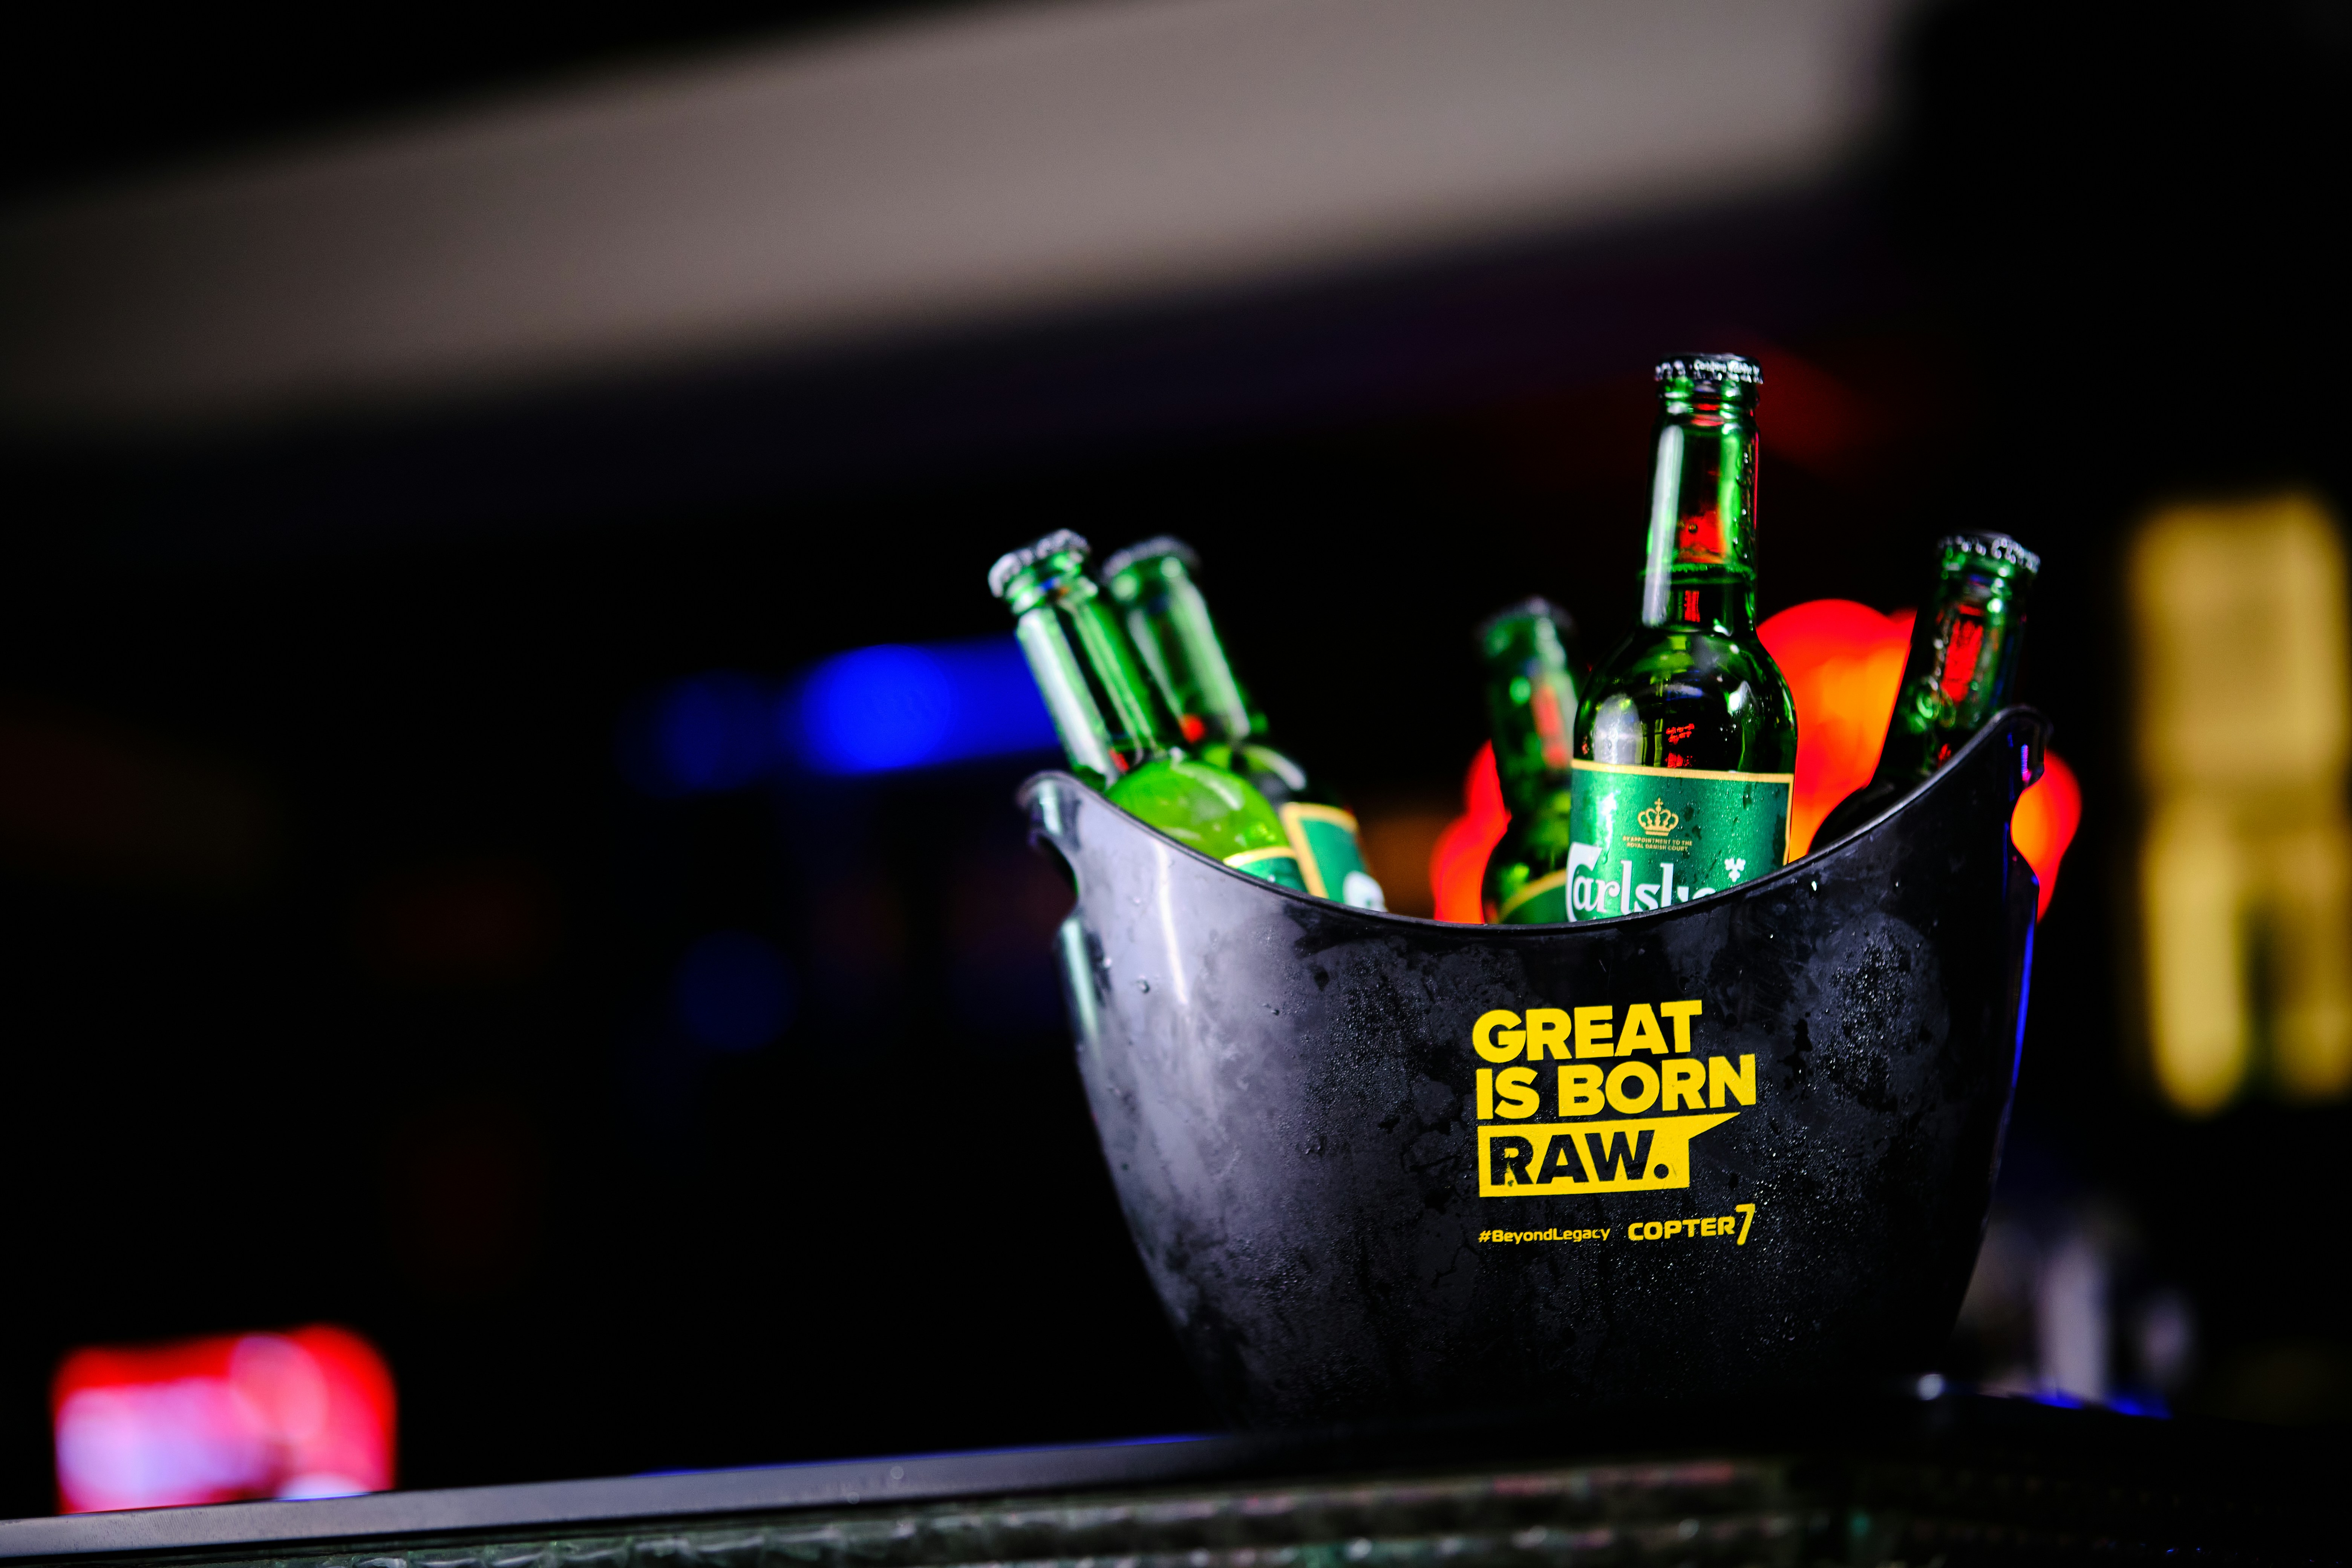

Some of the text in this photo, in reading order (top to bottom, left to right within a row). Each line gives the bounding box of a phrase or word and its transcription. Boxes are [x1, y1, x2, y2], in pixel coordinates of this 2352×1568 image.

[1631, 836, 1671, 845] APPOINTMENT
[1472, 1000, 1702, 1063] GREAT
[1476, 1054, 1756, 1119] IS BORN
[1490, 1130, 1669, 1186] RAW.
[1478, 1228, 1611, 1245] #BeyondLegacy
[1628, 1203, 1756, 1245] COPTER7
